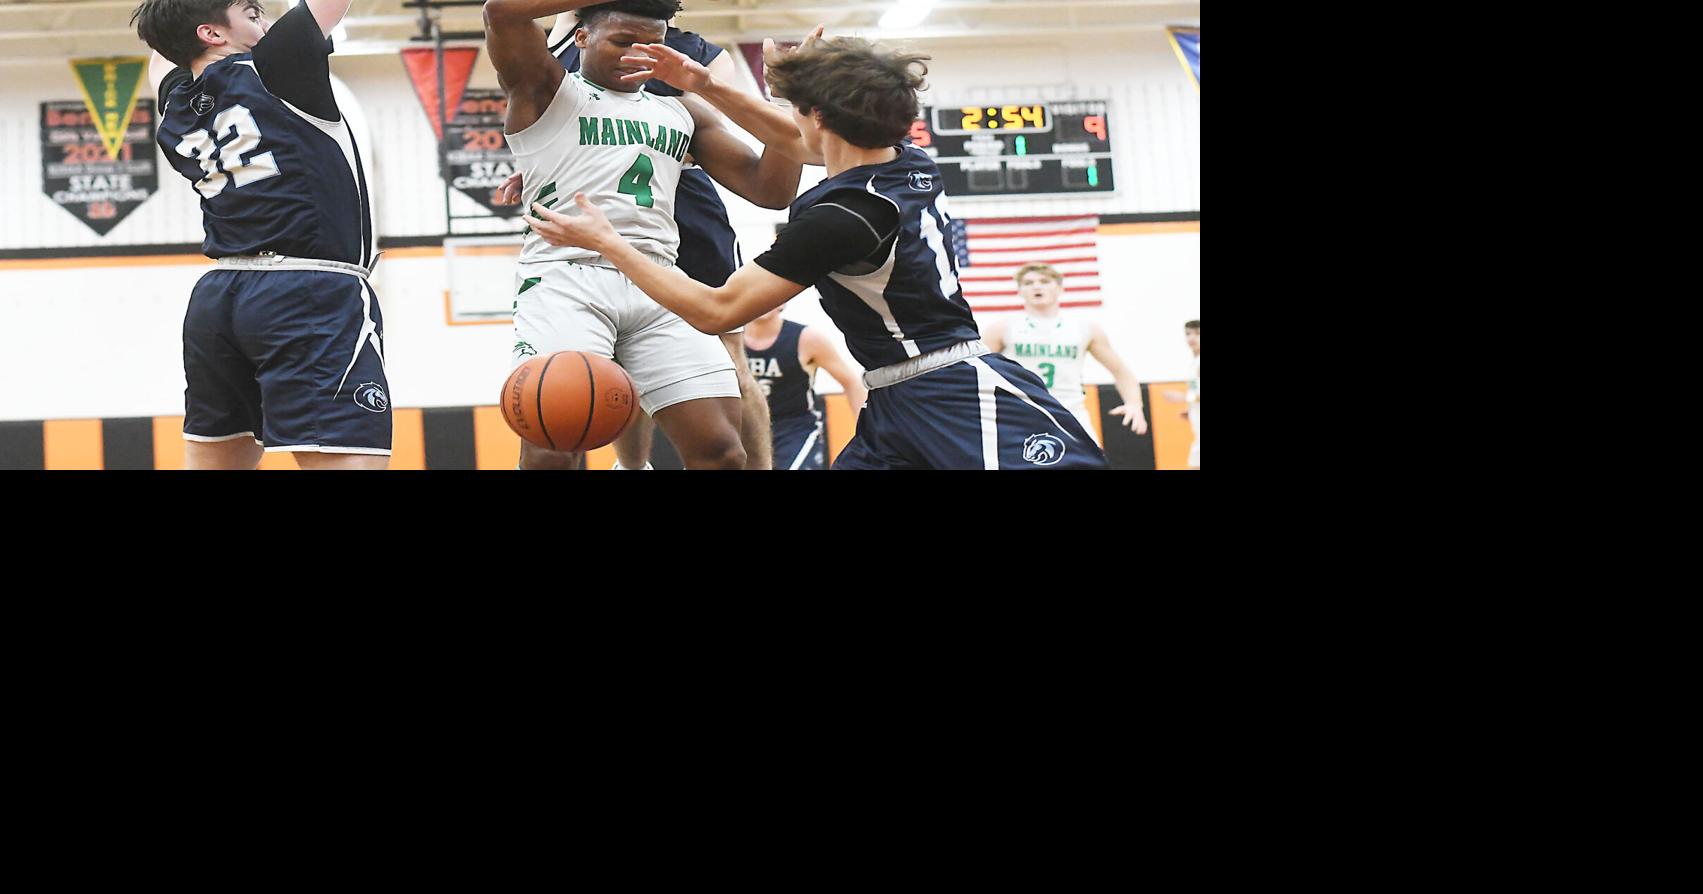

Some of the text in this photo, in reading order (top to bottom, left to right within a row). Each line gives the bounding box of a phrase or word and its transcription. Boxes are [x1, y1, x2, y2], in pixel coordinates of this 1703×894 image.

[961, 105, 1045, 131] 2:54
[1083, 116, 1106, 141] 9
[463, 130, 504, 152] 20
[579, 116, 690, 162] MAINLAND
[1015, 135, 1026, 156] 1
[174, 104, 281, 199] 32
[69, 174, 132, 192] STATE
[617, 152, 655, 208] 4
[1088, 165, 1099, 186] 1
[1014, 343, 1078, 359] MAINLAND
[749, 357, 783, 378] BA
[1038, 362, 1055, 388] 3
